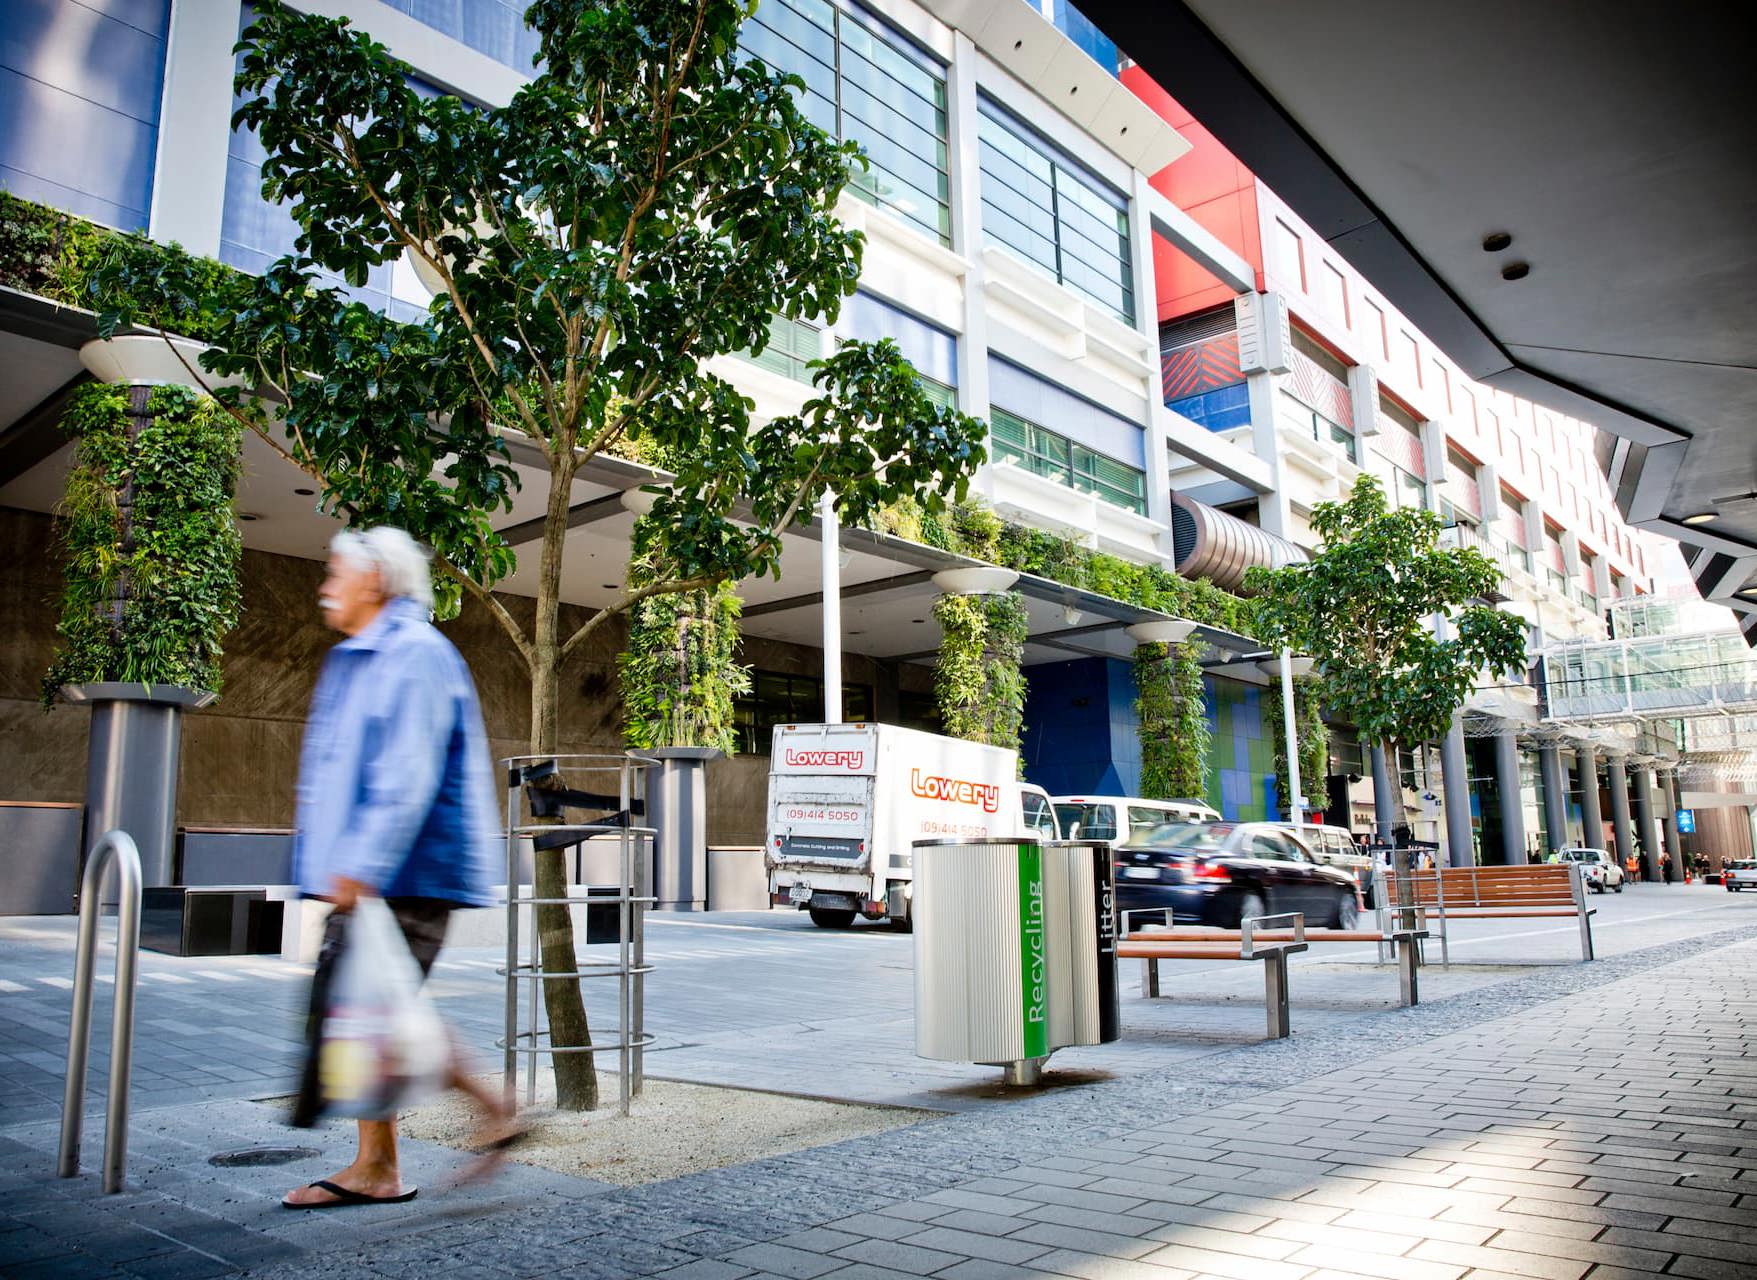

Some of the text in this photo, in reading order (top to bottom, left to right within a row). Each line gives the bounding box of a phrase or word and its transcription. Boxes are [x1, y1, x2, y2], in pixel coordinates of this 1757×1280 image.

[786, 748, 863, 769] Lowery
[911, 768, 999, 812] Lowery
[828, 810, 858, 821] 5050
[1101, 880, 1115, 953] Litter
[1026, 880, 1044, 1023] Recycling
